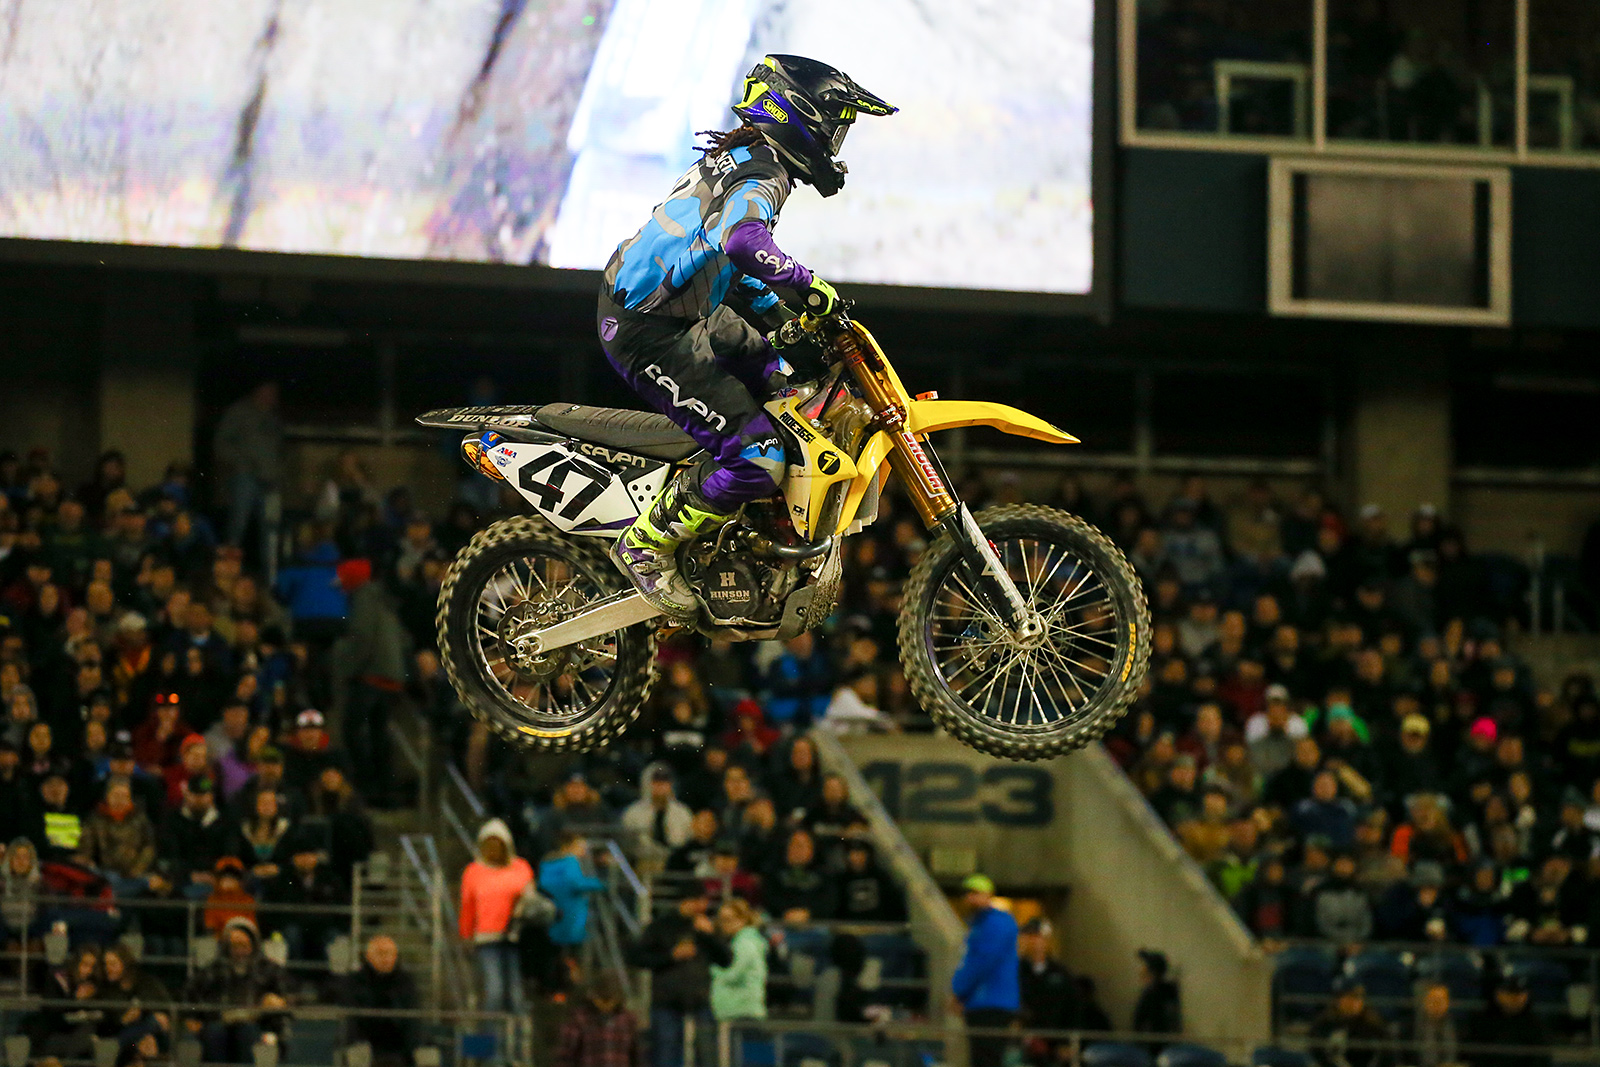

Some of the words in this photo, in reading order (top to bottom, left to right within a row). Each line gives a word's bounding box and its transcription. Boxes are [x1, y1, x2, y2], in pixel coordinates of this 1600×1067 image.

[764, 101, 786, 121] SHOEI
[447, 414, 530, 428] DUNLOP
[821, 452, 839, 472] 7
[902, 432, 945, 490] SHOWA
[518, 450, 614, 521] 47
[719, 572, 737, 587] H
[710, 590, 750, 599] HINSON
[1121, 622, 1136, 682] DUNLOP
[861, 760, 1055, 827] 123
